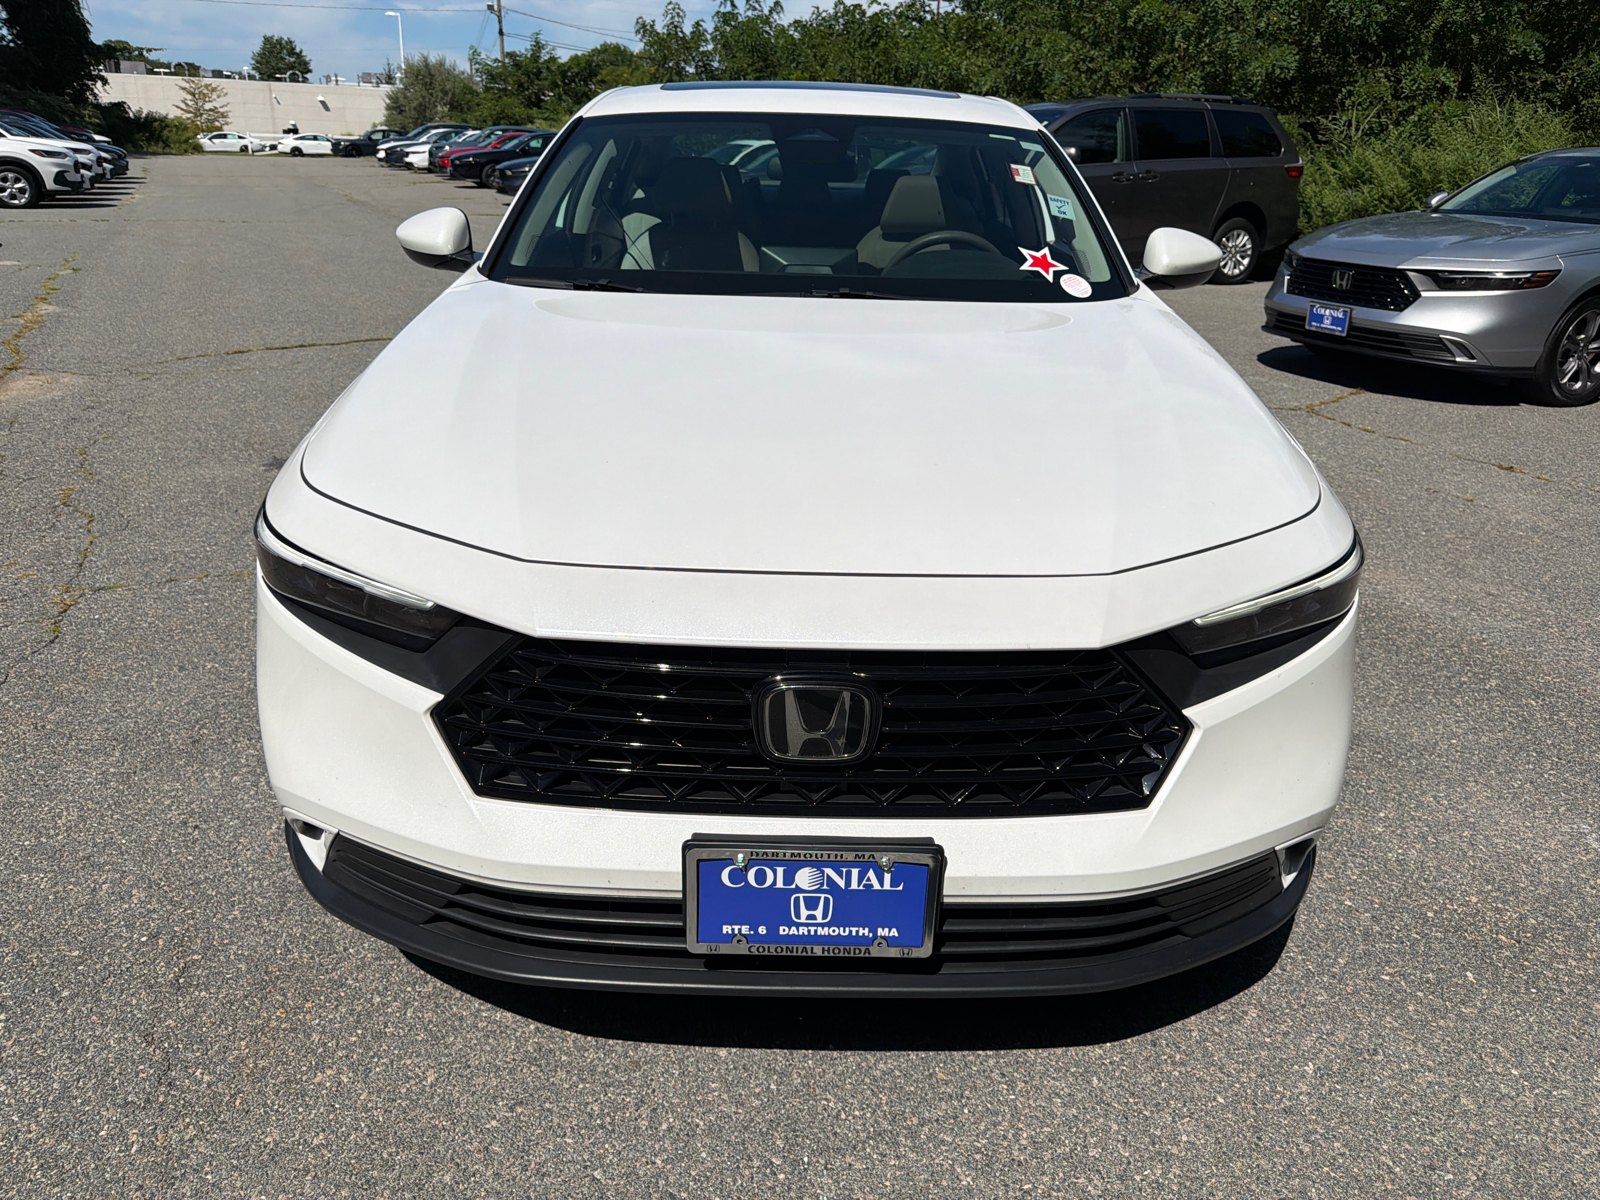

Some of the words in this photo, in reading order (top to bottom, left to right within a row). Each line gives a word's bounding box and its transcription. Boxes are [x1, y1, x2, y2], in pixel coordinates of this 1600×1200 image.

[1049, 196, 1069, 205] SAFETY
[720, 865, 904, 891] COLONIAL
[722, 925, 754, 935] RTE.
[758, 925, 767, 935] 6
[779, 926, 873, 938] DARTMOUTH,
[877, 928, 899, 937] MA
[747, 945, 817, 955] COLONIAL
[821, 947, 872, 956] HONDA
